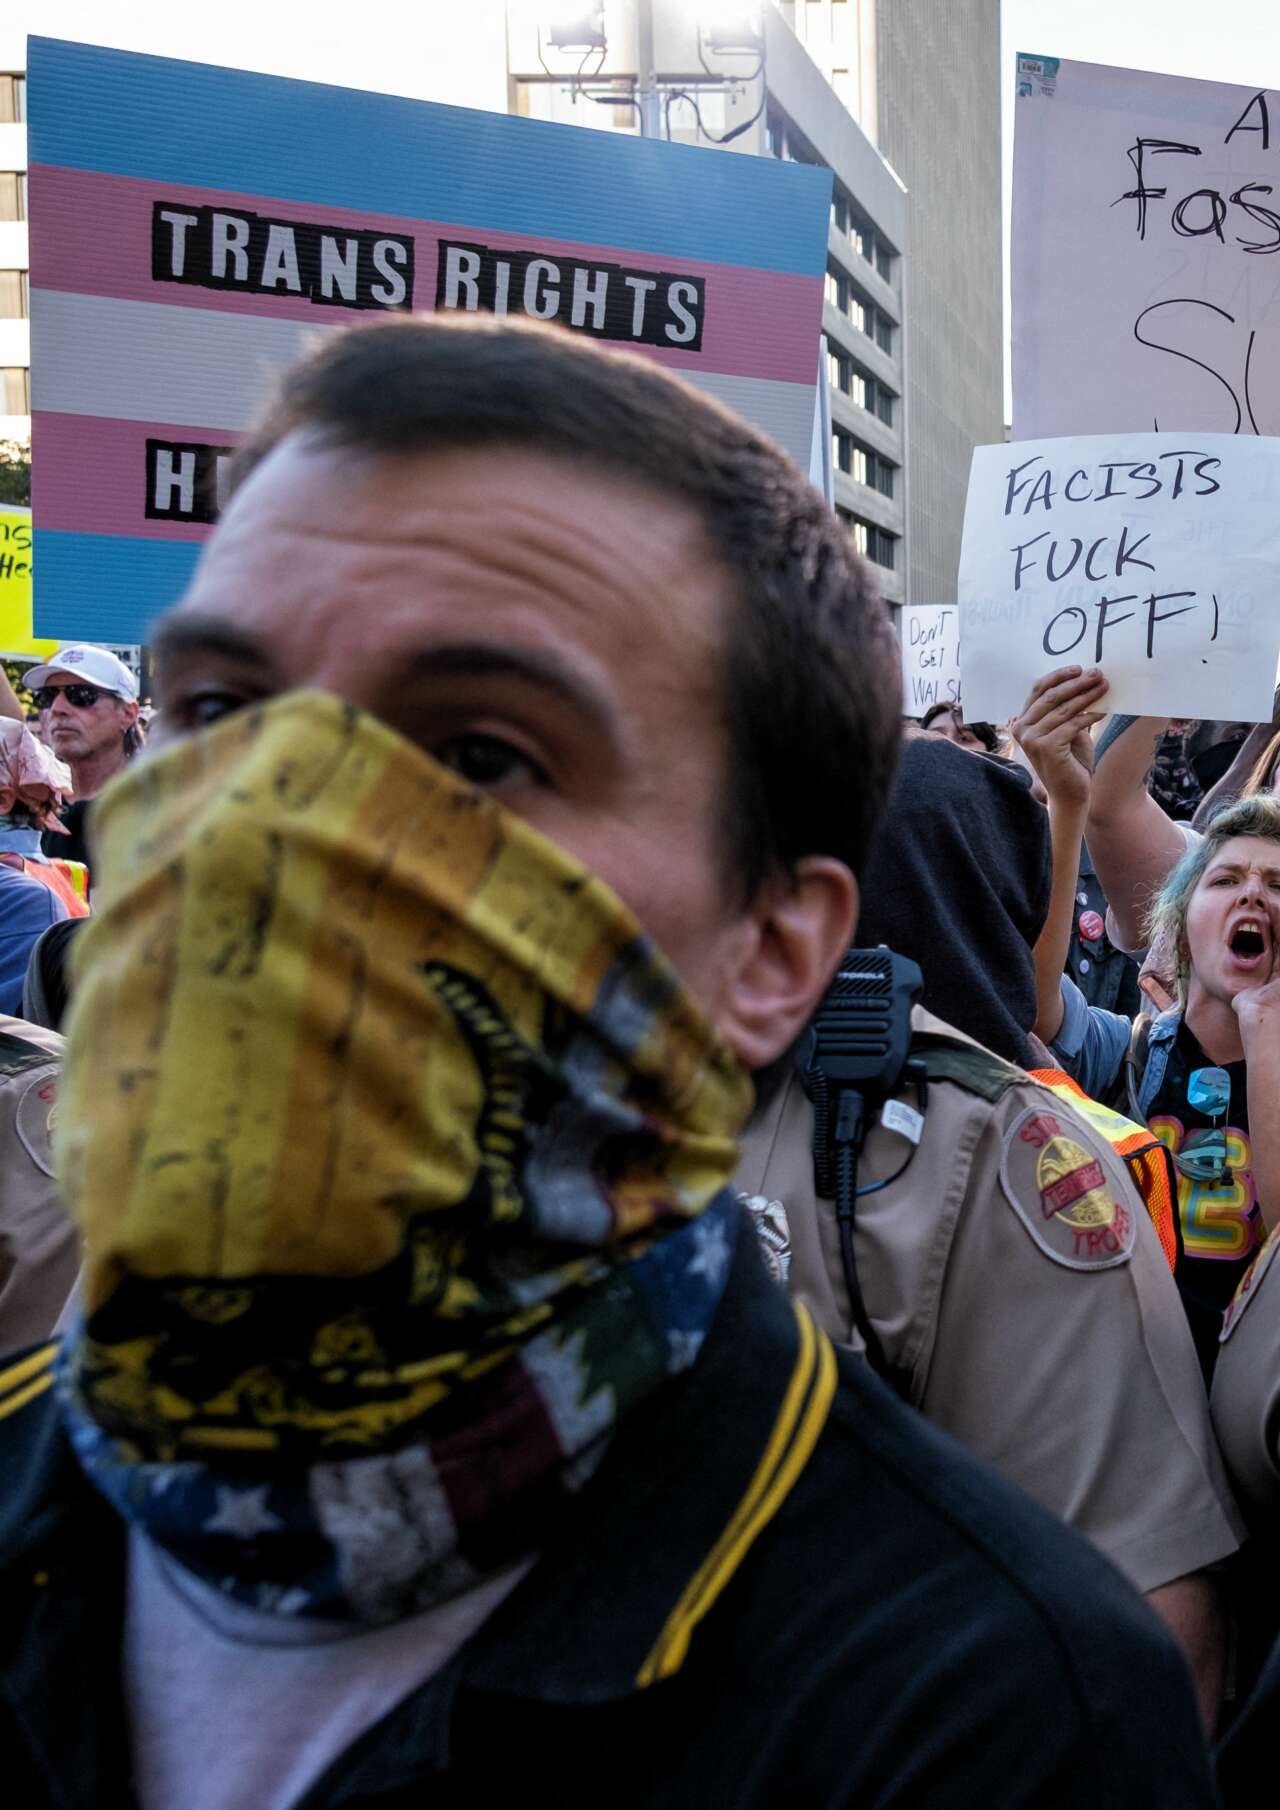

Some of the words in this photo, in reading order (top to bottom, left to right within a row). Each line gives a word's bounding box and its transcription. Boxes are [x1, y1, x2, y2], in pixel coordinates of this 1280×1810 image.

[161, 210, 408, 305] TRANS
[445, 246, 699, 343] RIGHTS
[1004, 451, 1222, 516] FACISTS
[1010, 526, 1156, 592] FUCK
